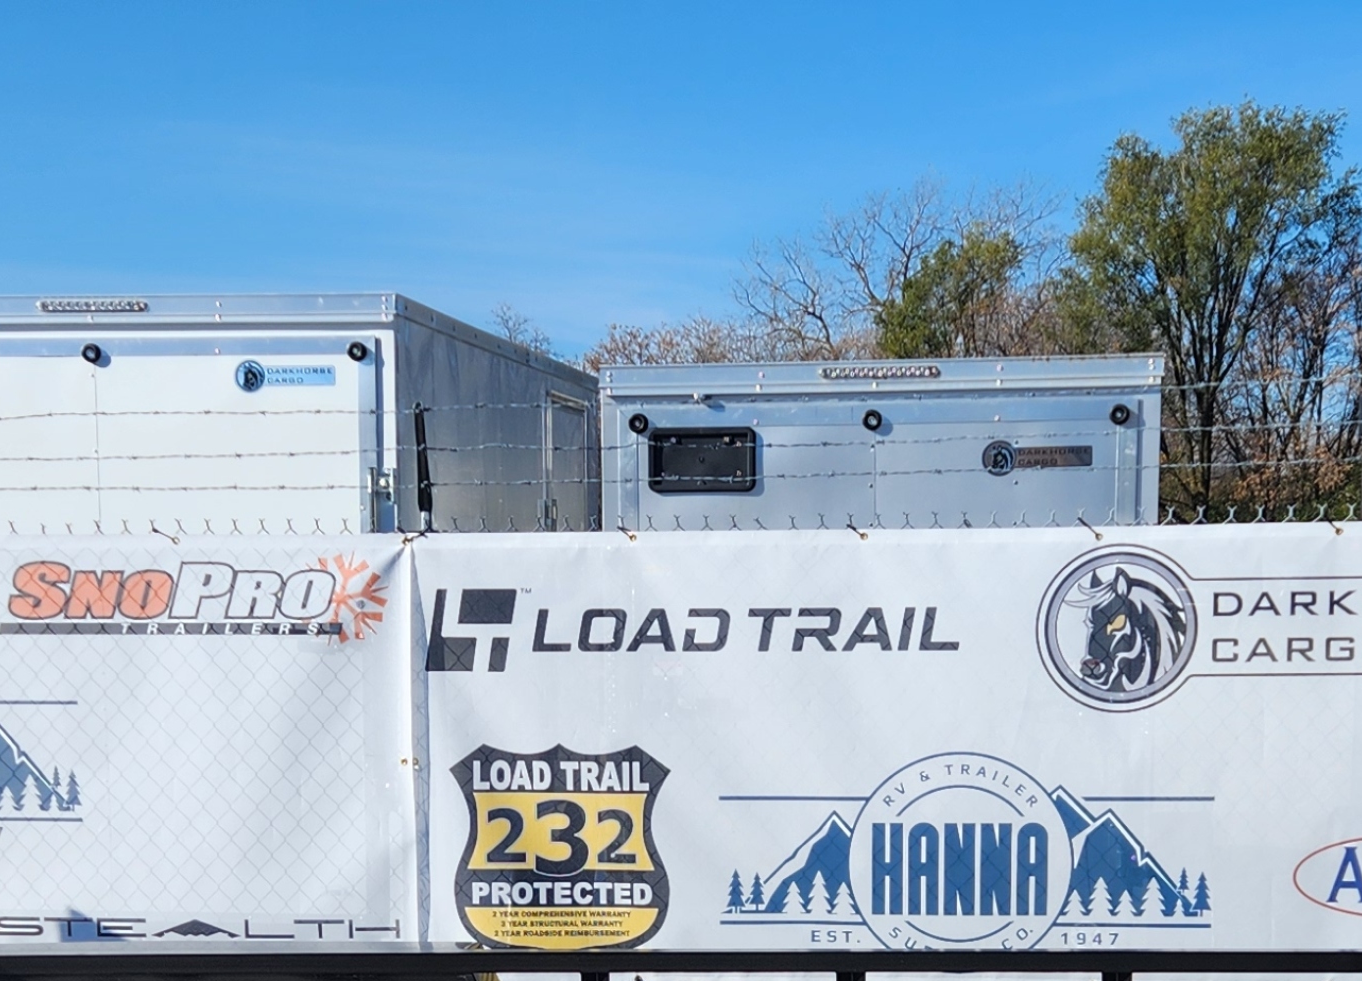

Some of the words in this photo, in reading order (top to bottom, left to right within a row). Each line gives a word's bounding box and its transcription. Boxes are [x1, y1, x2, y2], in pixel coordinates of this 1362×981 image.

[121, 623, 322, 635] TRAILERS
[532, 608, 731, 652] LOAD
[748, 606, 960, 652] TRAIL
[472, 760, 551, 791] LOAD
[560, 760, 650, 792] TRAIL
[883, 783, 905, 807] RV
[920, 771, 930, 782] &
[944, 764, 1038, 807] TRAILER
[484, 799, 640, 876] 232
[872, 822, 1048, 916] HANNA
[472, 882, 653, 908] PROTECTED
[811, 930, 861, 943] EST.
[1061, 932, 1119, 945] 1947
